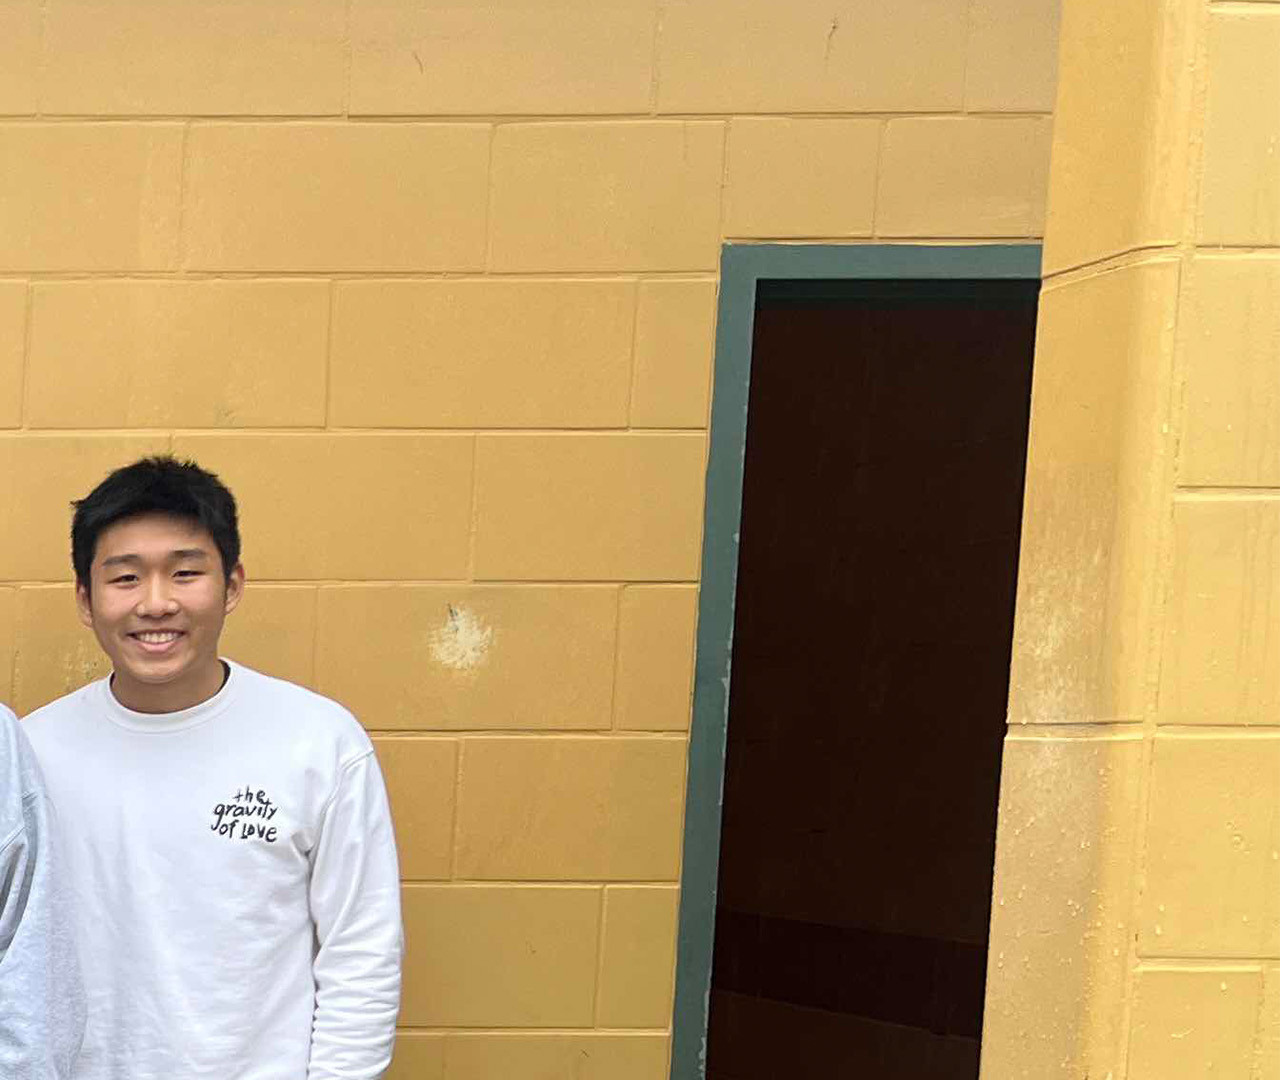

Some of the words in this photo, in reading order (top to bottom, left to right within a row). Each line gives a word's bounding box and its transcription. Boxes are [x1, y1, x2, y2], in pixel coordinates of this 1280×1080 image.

[233, 785, 266, 803] the
[211, 799, 278, 831] gravity
[219, 819, 239, 838] of
